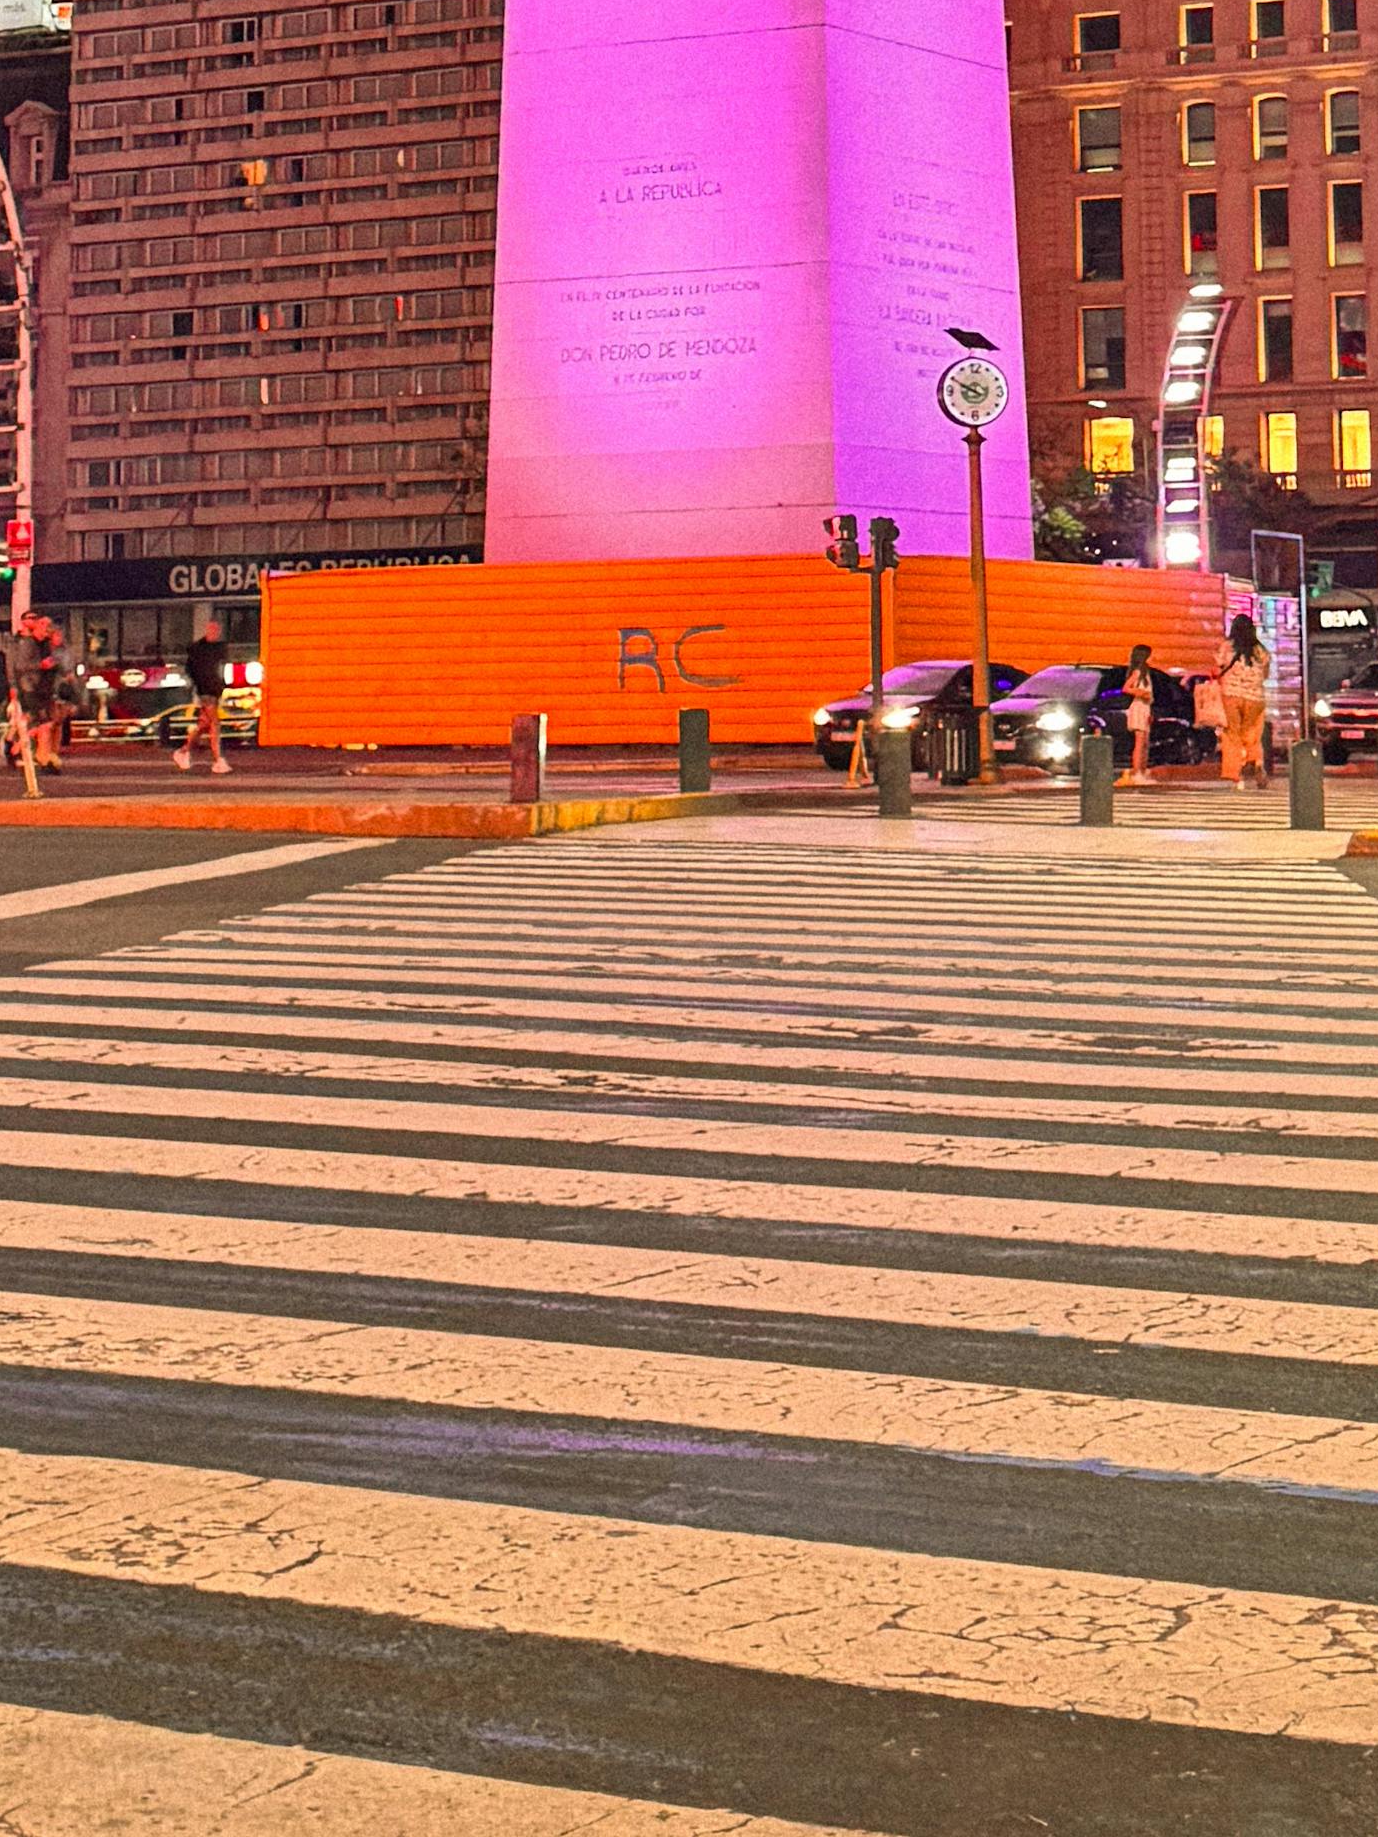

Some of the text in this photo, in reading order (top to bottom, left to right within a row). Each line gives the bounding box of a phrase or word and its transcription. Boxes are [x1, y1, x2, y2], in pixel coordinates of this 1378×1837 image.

[599, 189, 608, 203] A
[615, 186, 634, 203] LA
[560, 336, 757, 364] DON PEDRO DE MENDOZA
[968, 362, 982, 374] 12
[946, 384, 954, 397] 9
[996, 385, 1005, 398] 3
[971, 410, 980, 422] 6
[1320, 608, 1369, 628] BBVA
